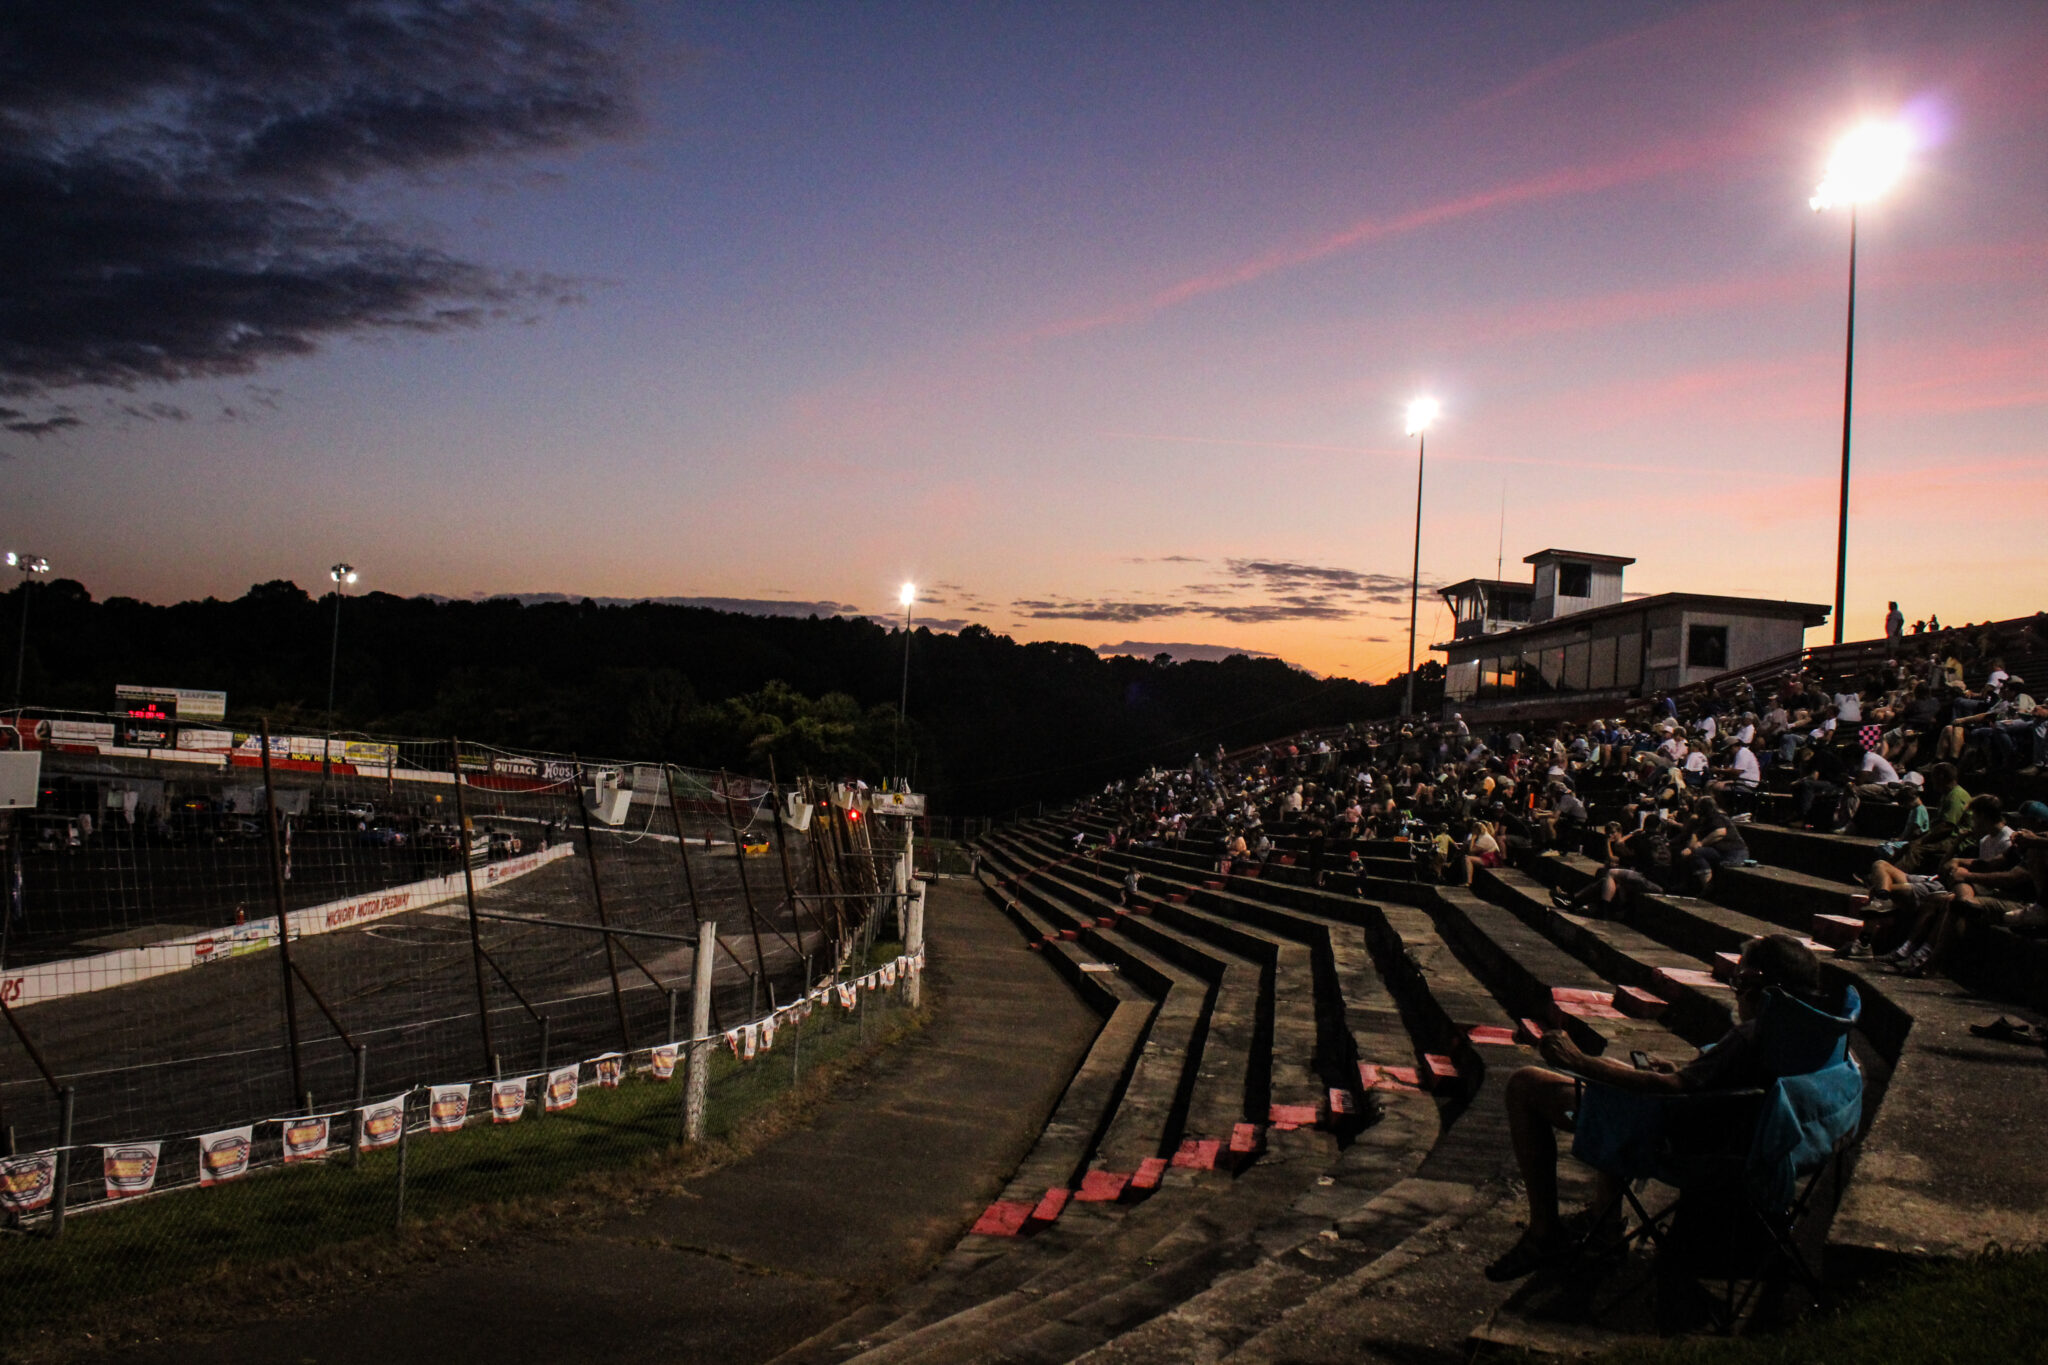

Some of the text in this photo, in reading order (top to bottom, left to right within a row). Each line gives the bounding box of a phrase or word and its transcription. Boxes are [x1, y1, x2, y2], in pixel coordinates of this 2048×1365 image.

[291, 753, 312, 761] NOW
[494, 761, 539, 775] OUTBACK
[326, 892, 410, 928] HICKORY MOTOR SPEEDWAY
